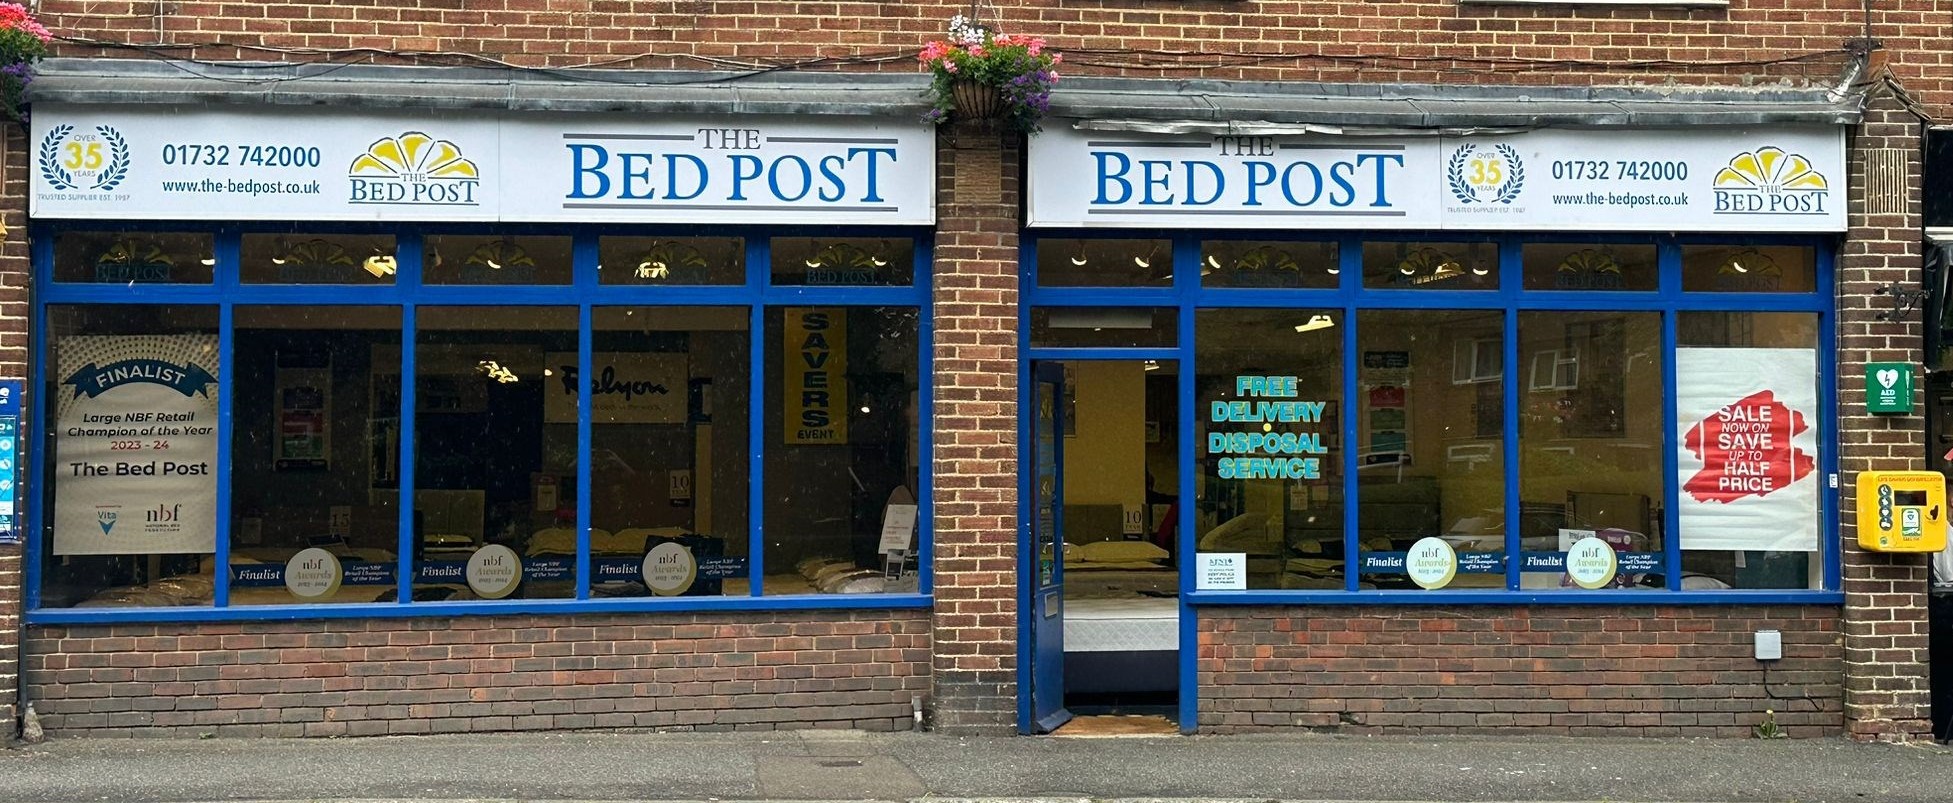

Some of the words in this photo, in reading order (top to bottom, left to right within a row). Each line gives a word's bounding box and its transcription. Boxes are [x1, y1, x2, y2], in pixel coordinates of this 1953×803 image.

[73, 134, 97, 142] OVER
[698, 128, 761, 150] THE
[1215, 136, 1275, 157] THE
[65, 142, 103, 170] 35
[162, 144, 229, 166] 01732
[238, 145, 321, 168] 742000
[401, 173, 426, 182] THE
[565, 143, 709, 200] BED
[726, 148, 898, 203] POST
[1469, 159, 1502, 185] 35
[1552, 160, 1608, 181] 01732
[1617, 161, 1688, 181] 742000
[1090, 151, 1226, 206] BED
[1242, 153, 1404, 208] POST
[162, 179, 321, 196] www.the-bedpost.co.uk
[349, 179, 405, 202] BED
[412, 181, 480, 203] POST
[1759, 185, 1781, 194] THE
[1552, 191, 1689, 209] www.the-bedpost.co.uk
[1714, 190, 1763, 212] BED
[1769, 192, 1829, 213] POST
[96, 365, 186, 388] FINALIST
[801, 313, 830, 428] SAVERS
[1236, 376, 1298, 397] FREE
[83, 413, 121, 425] Large
[125, 413, 153, 422] NBF
[156, 411, 195, 422] Retail
[1211, 401, 1326, 422] DELIVERY
[1719, 405, 1772, 422] SALE
[68, 427, 137, 438] Champion
[141, 426, 155, 436] of
[158, 426, 180, 436] the
[183, 425, 213, 435] Year
[797, 429, 834, 439] EVENT
[1721, 423, 1749, 433] NOW
[1752, 423, 1770, 433] ON
[111, 441, 142, 450] 2023
[153, 440, 170, 450] 24
[1208, 432, 1328, 453] DISPOSAL
[1719, 433, 1773, 450] SAVE
[1729, 451, 1744, 461] UP
[1748, 451, 1763, 461] TO
[70, 462, 109, 476] The
[116, 461, 156, 476] Bed
[164, 462, 208, 475] Post
[1218, 457, 1320, 479] SERVICE
[1724, 461, 1770, 476] HALF
[672, 475, 689, 488] 10
[1719, 477, 1774, 492] PRICE
[98, 510, 117, 519] Vita
[147, 503, 180, 522] nbf
[1126, 510, 1142, 524] 10
[659, 553, 678, 564] nbf
[1421, 548, 1440, 558] nbf
[1582, 547, 1600, 558] nbf
[302, 558, 323, 570] nbf
[483, 556, 503, 566] nbf
[1367, 557, 1402, 567] Finalist
[1527, 556, 1563, 566] Finalist
[239, 569, 281, 580] Finalist
[422, 567, 462, 576] Finalist
[600, 564, 638, 574] Finalist
